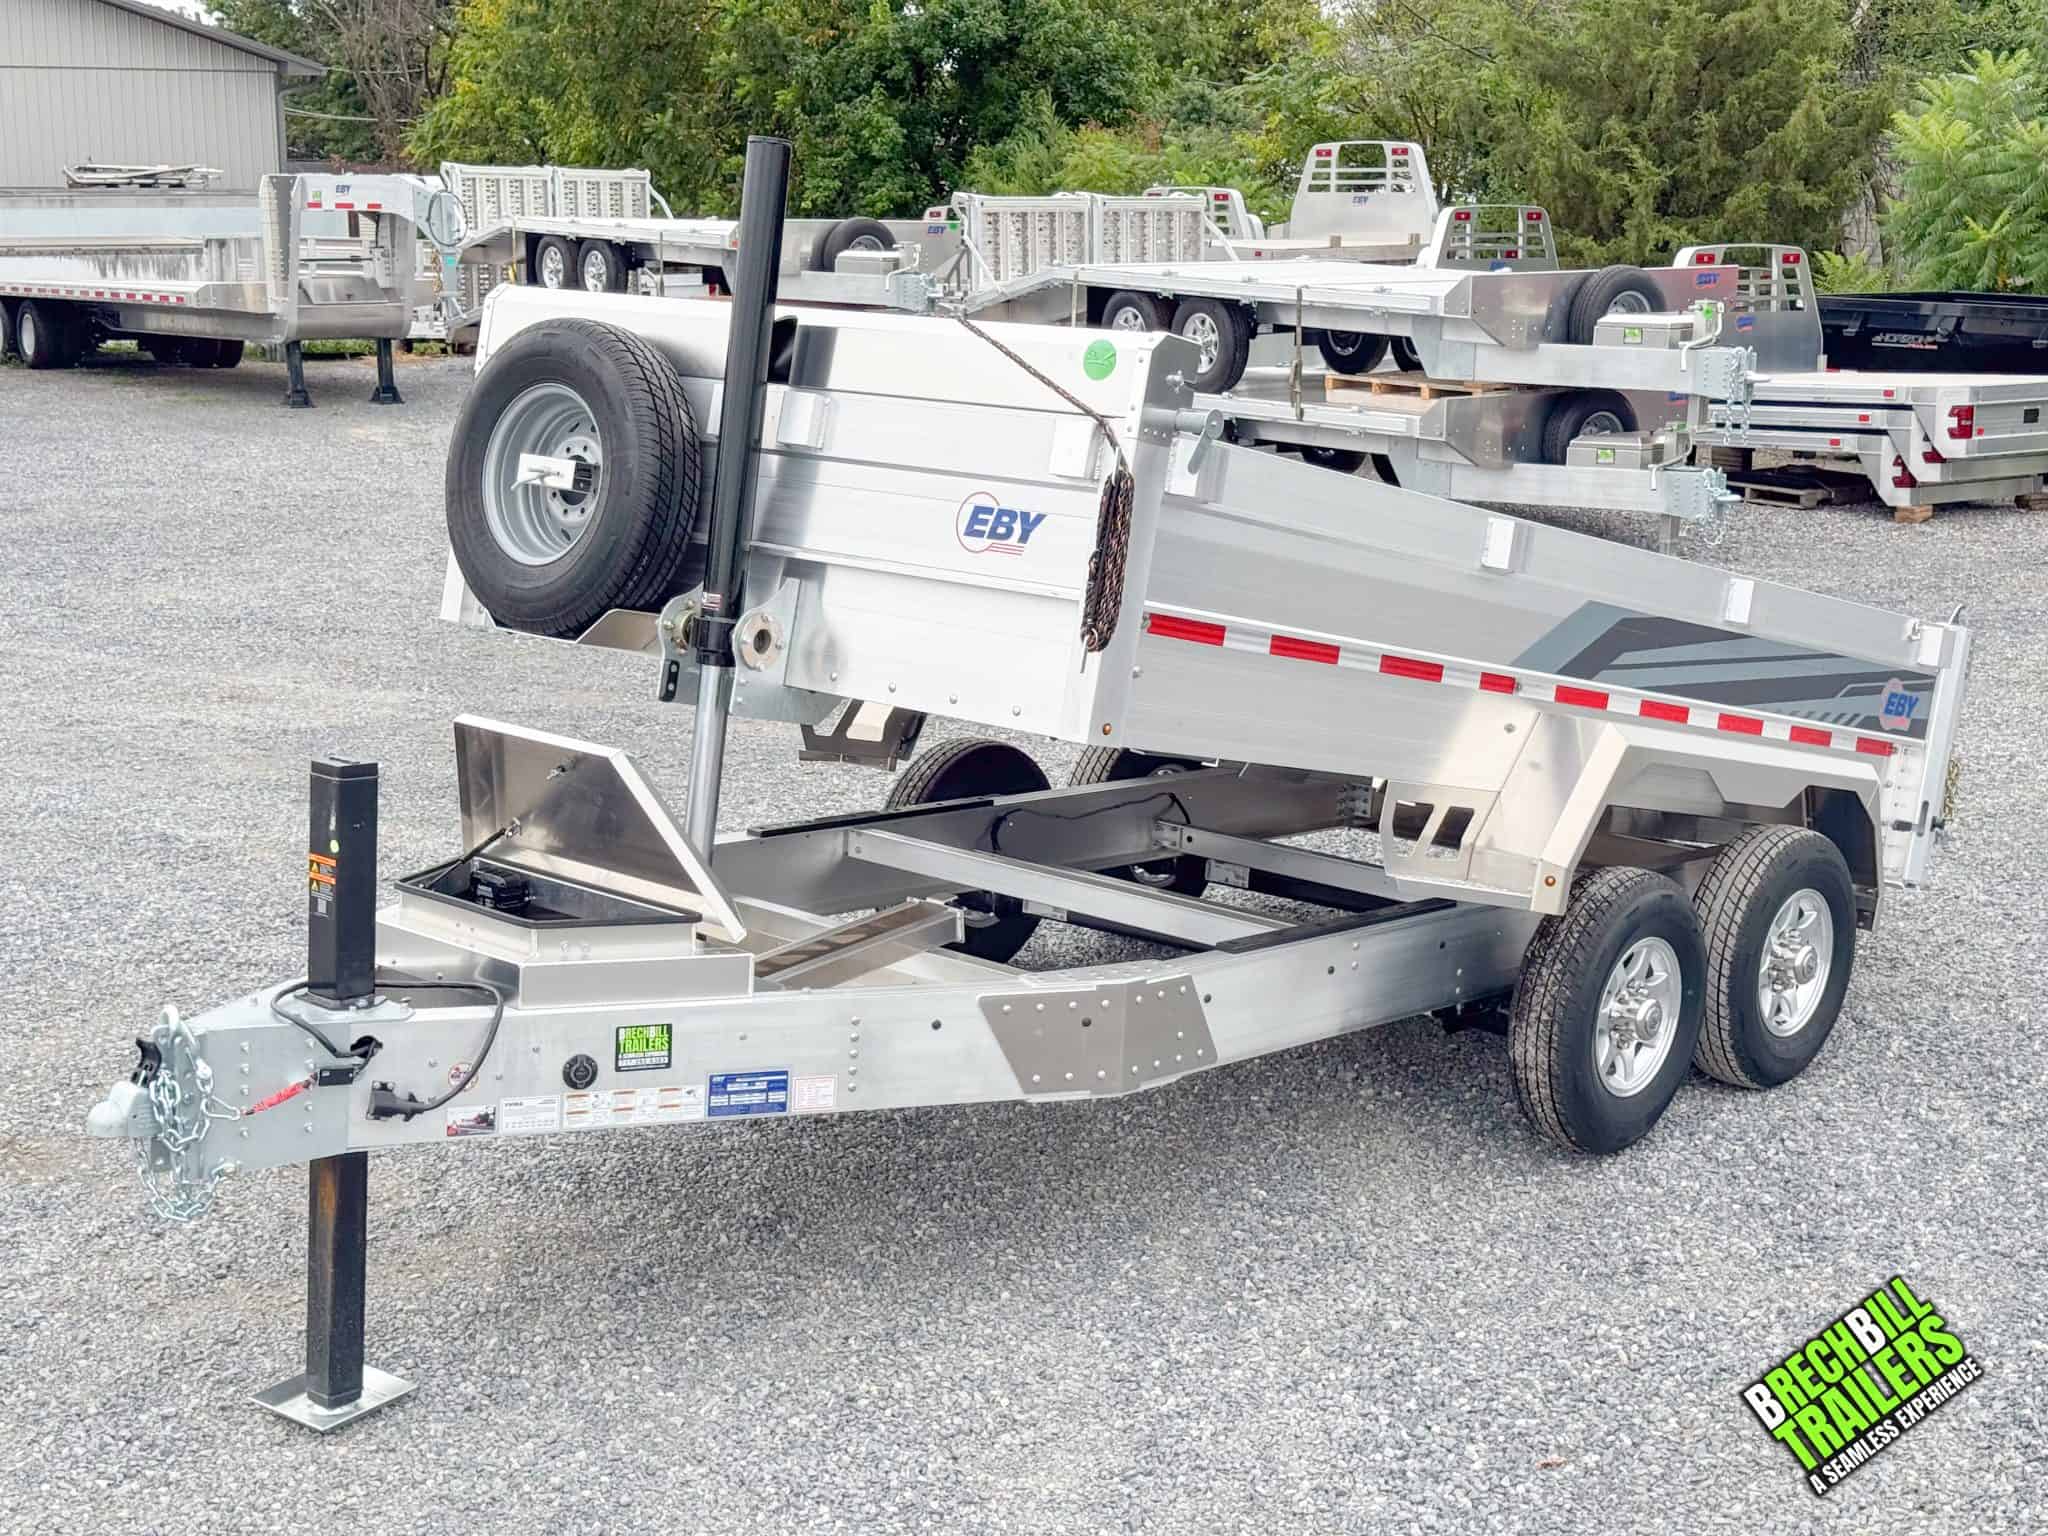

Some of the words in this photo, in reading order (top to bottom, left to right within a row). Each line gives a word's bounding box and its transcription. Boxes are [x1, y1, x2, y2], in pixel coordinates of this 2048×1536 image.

[963, 505, 1048, 544] EBY
[1884, 692, 1919, 718] EBY
[619, 1025, 669, 1041] BRECHBILL
[619, 1037, 669, 1054] TRAILERS
